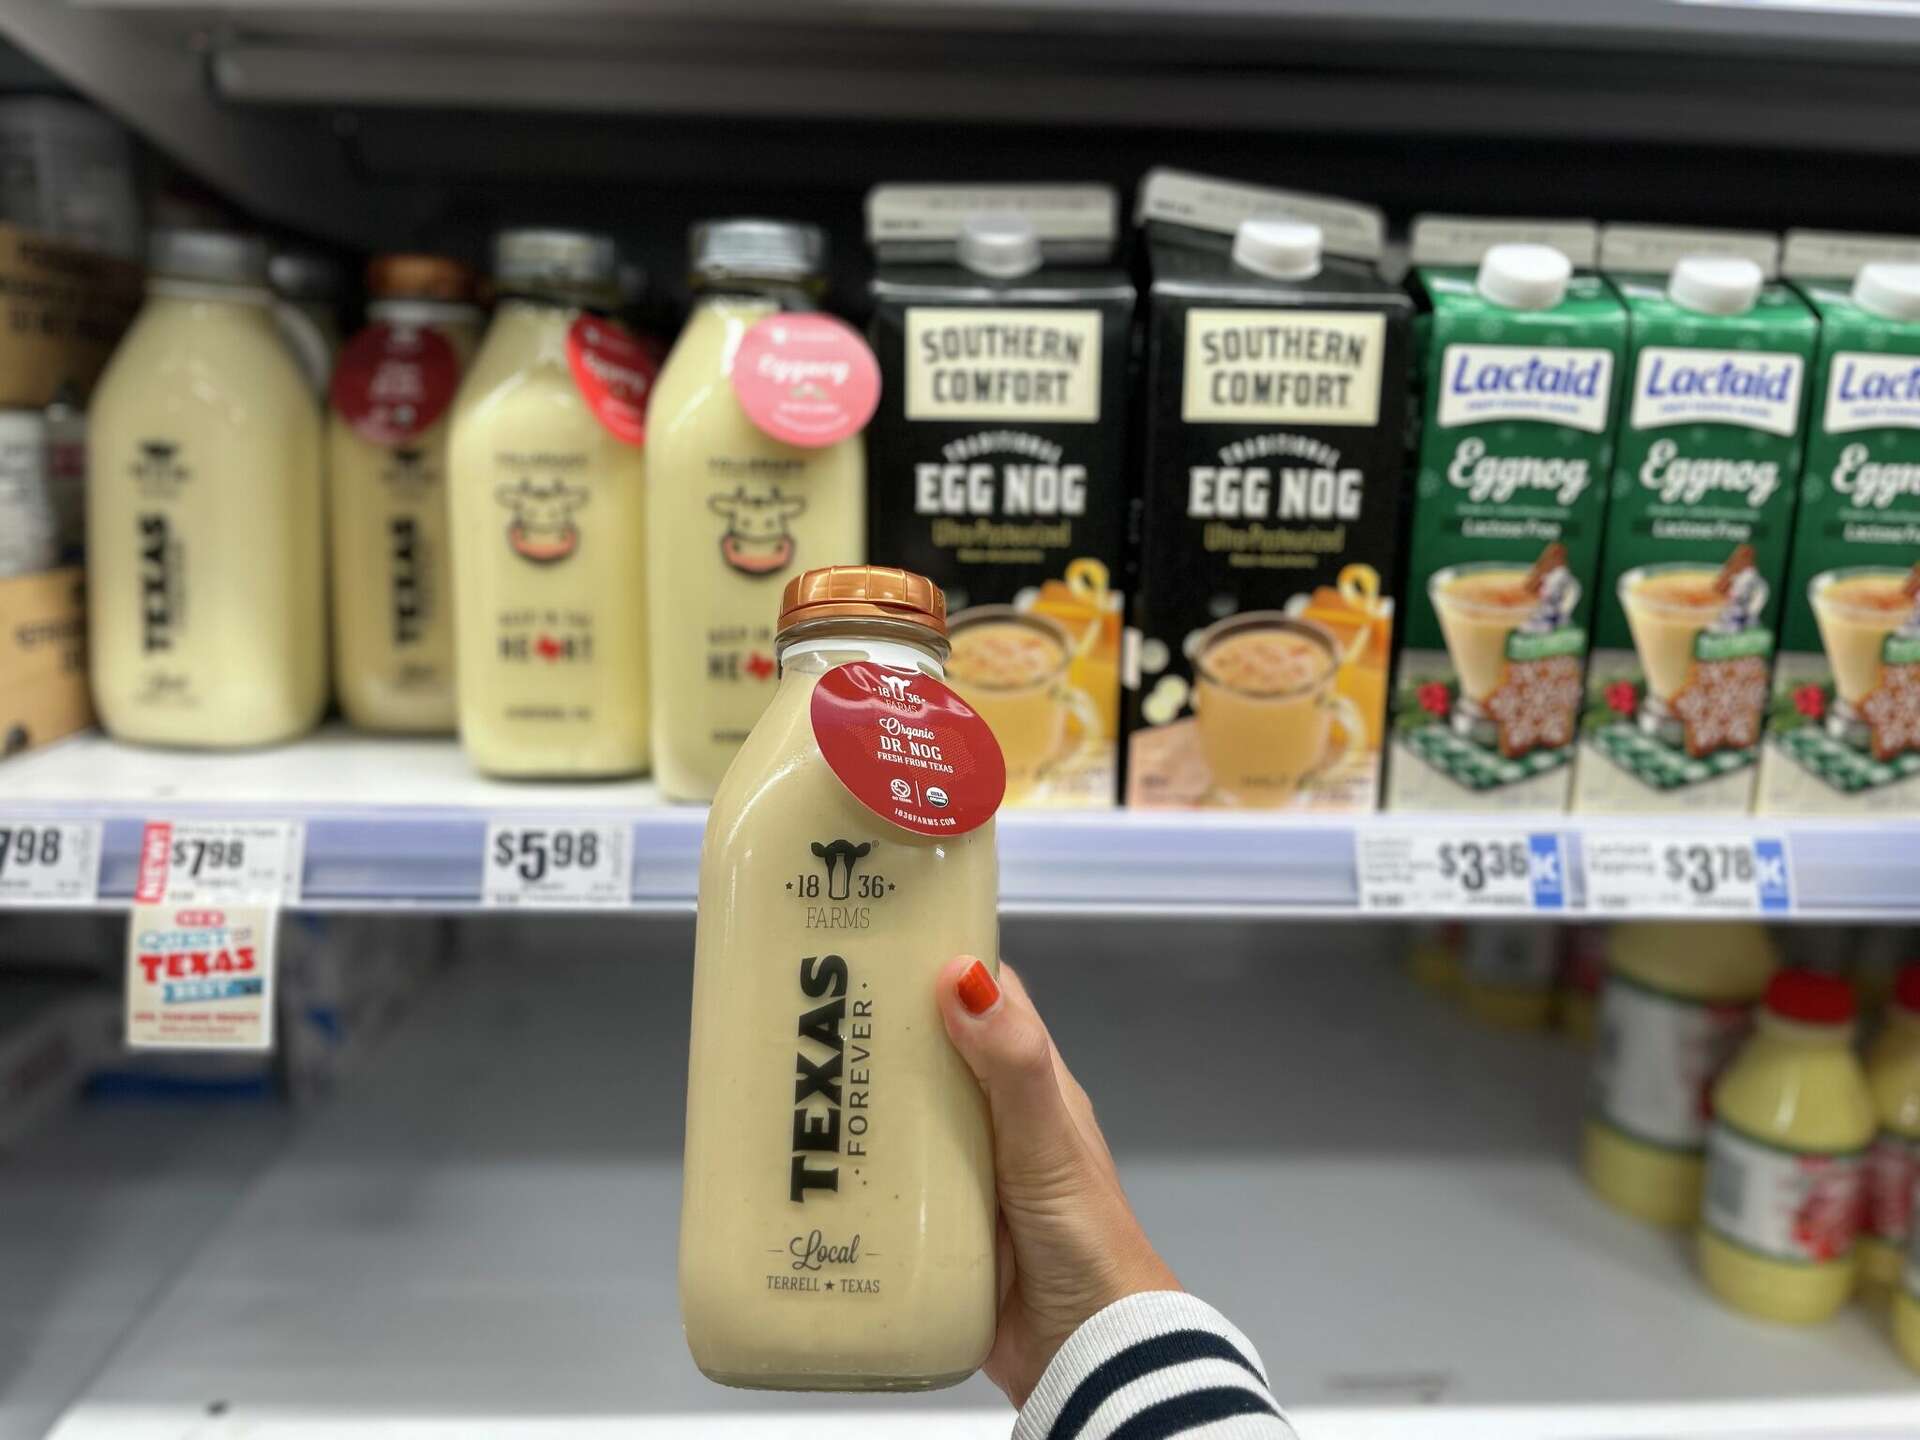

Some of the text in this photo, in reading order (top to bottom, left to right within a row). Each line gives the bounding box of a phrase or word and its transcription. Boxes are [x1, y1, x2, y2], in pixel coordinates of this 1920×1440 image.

[921, 325, 1084, 365] SOUTHERN
[1202, 325, 1367, 368] SOUTHERN
[933, 369, 1070, 405] COMFORT
[1212, 370, 1352, 408] COMFORT
[1451, 354, 1600, 398] Lactaid
[1646, 356, 1794, 401] Lactaid
[915, 463, 1087, 516] EGG NOG
[1447, 437, 1590, 505] Eggnog
[1639, 438, 1780, 508] Eggnog
[1187, 465, 1363, 521] EGG NOG
[139, 516, 171, 652] TEXAS
[392, 519, 420, 645] TEXAS
[879, 716, 935, 741] Organic
[880, 735, 942, 761] DR. NOG
[877, 751, 954, 774] FRESH FROM TEXAS
[894, 807, 957, 827] 1836FARMS.COM
[798, 874, 885, 898] 18 36
[806, 907, 871, 930] FARMS
[137, 946, 255, 983] TEXAS
[790, 954, 849, 1204] TEXAS
[846, 999, 874, 1157] FOREVER
[789, 1229, 861, 1271] Local
[766, 1275, 881, 1293] TERRELL TEXAS
